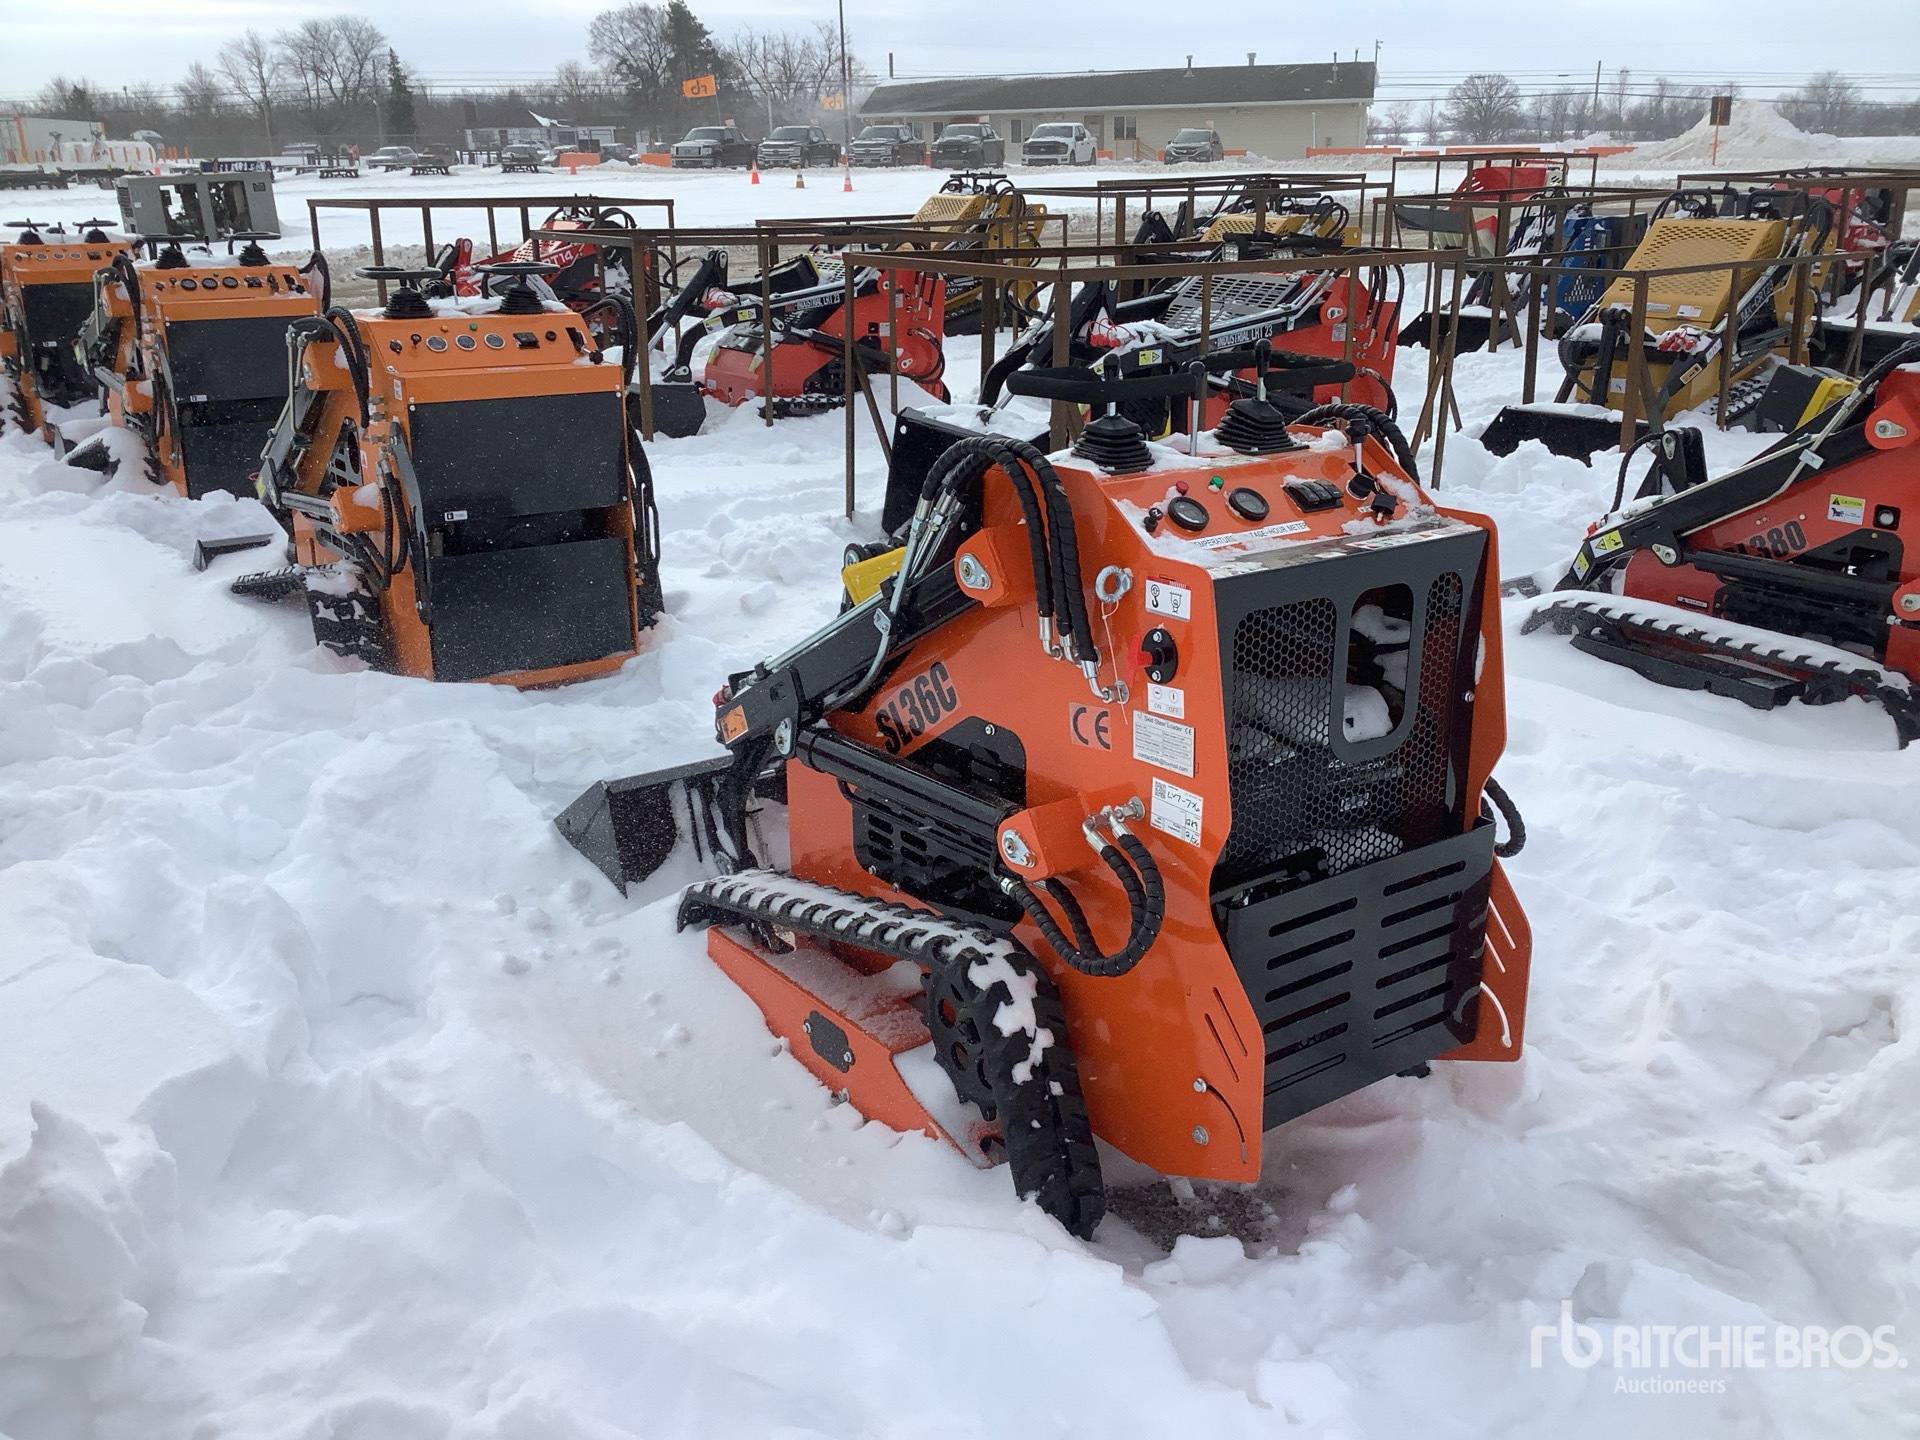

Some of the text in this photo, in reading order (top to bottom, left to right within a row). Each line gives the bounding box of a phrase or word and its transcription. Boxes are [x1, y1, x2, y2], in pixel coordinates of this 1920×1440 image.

[1217, 325, 1273, 347] INDUSTRIAL LRT 23
[875, 661, 957, 754] SL36C
[1168, 706, 1179, 714] OFF
[1072, 706, 1111, 750] CE
[1144, 715, 1182, 732] Skid Steer Loader
[1185, 727, 1192, 735] CE
